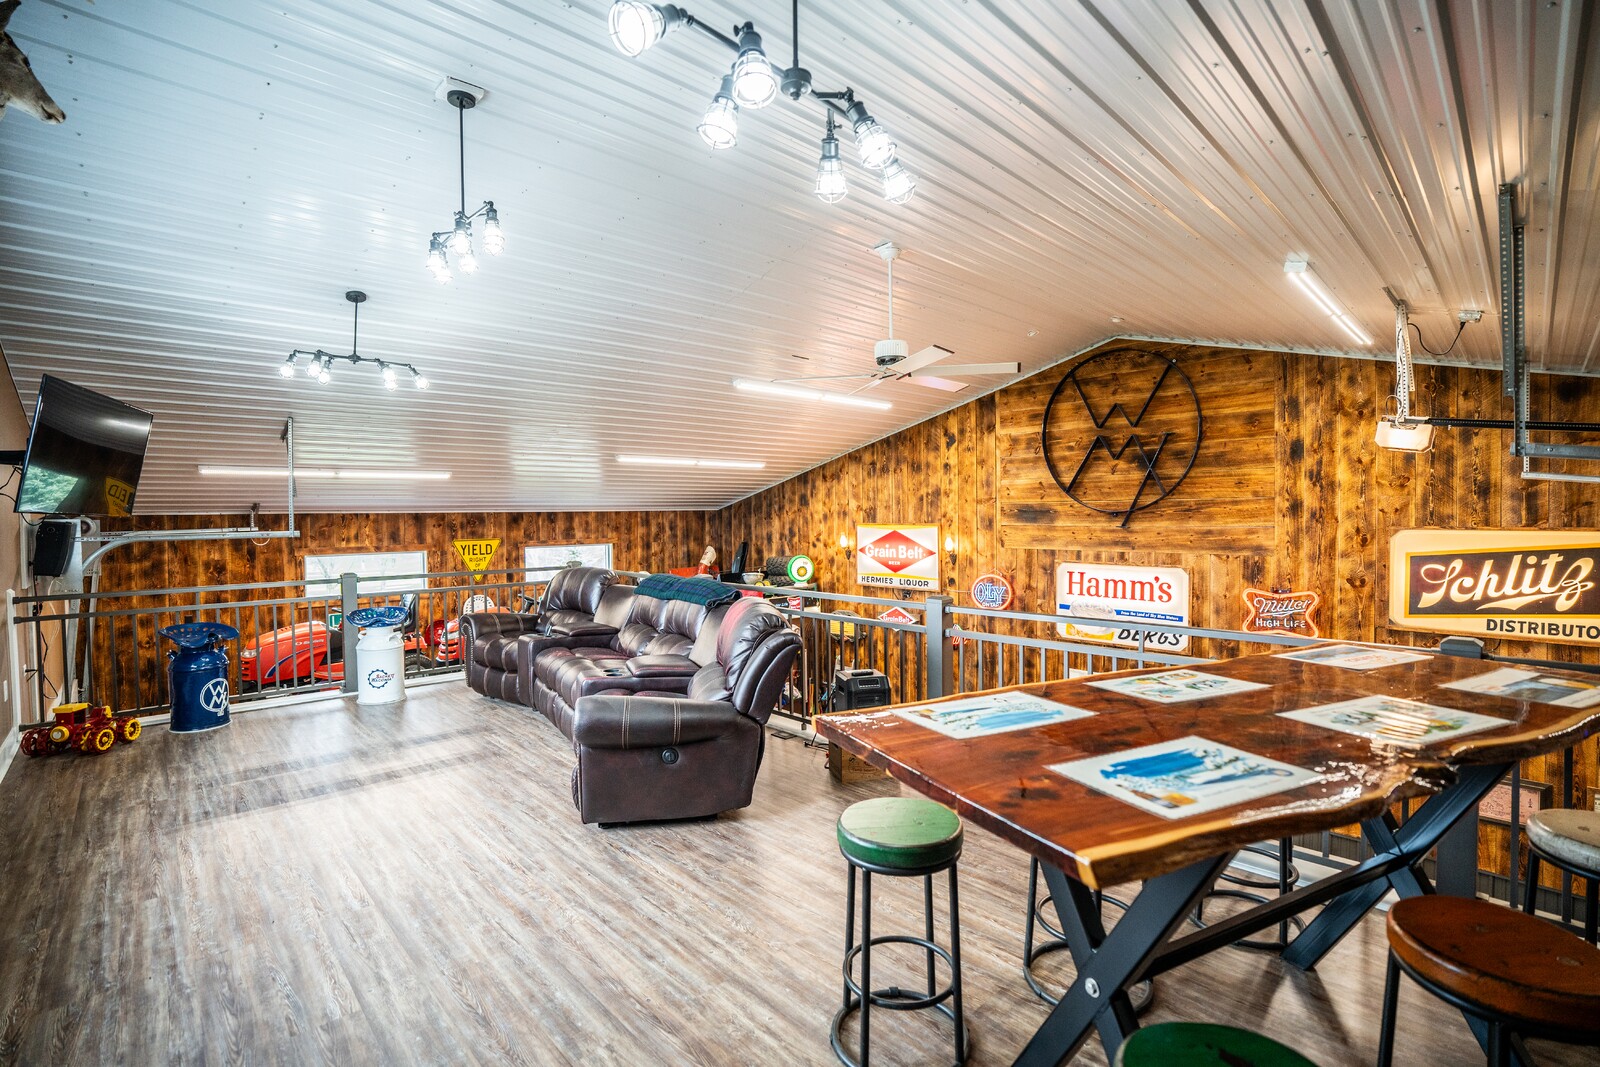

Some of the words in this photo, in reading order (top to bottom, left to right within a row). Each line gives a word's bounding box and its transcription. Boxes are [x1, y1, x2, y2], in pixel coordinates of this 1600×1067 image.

[460, 543, 493, 556] YIELD
[865, 543, 897, 558] Grain
[898, 544, 923, 559] Belt
[861, 575, 894, 584] HERMIES
[899, 578, 929, 587] LIQUOR
[1066, 570, 1172, 603] Hamm's
[1417, 553, 1595, 612] Schlitz
[974, 582, 1007, 602] OLY
[1253, 597, 1312, 613] Miller
[1255, 617, 1280, 628] HIGH
[1283, 618, 1306, 628] LIFE
